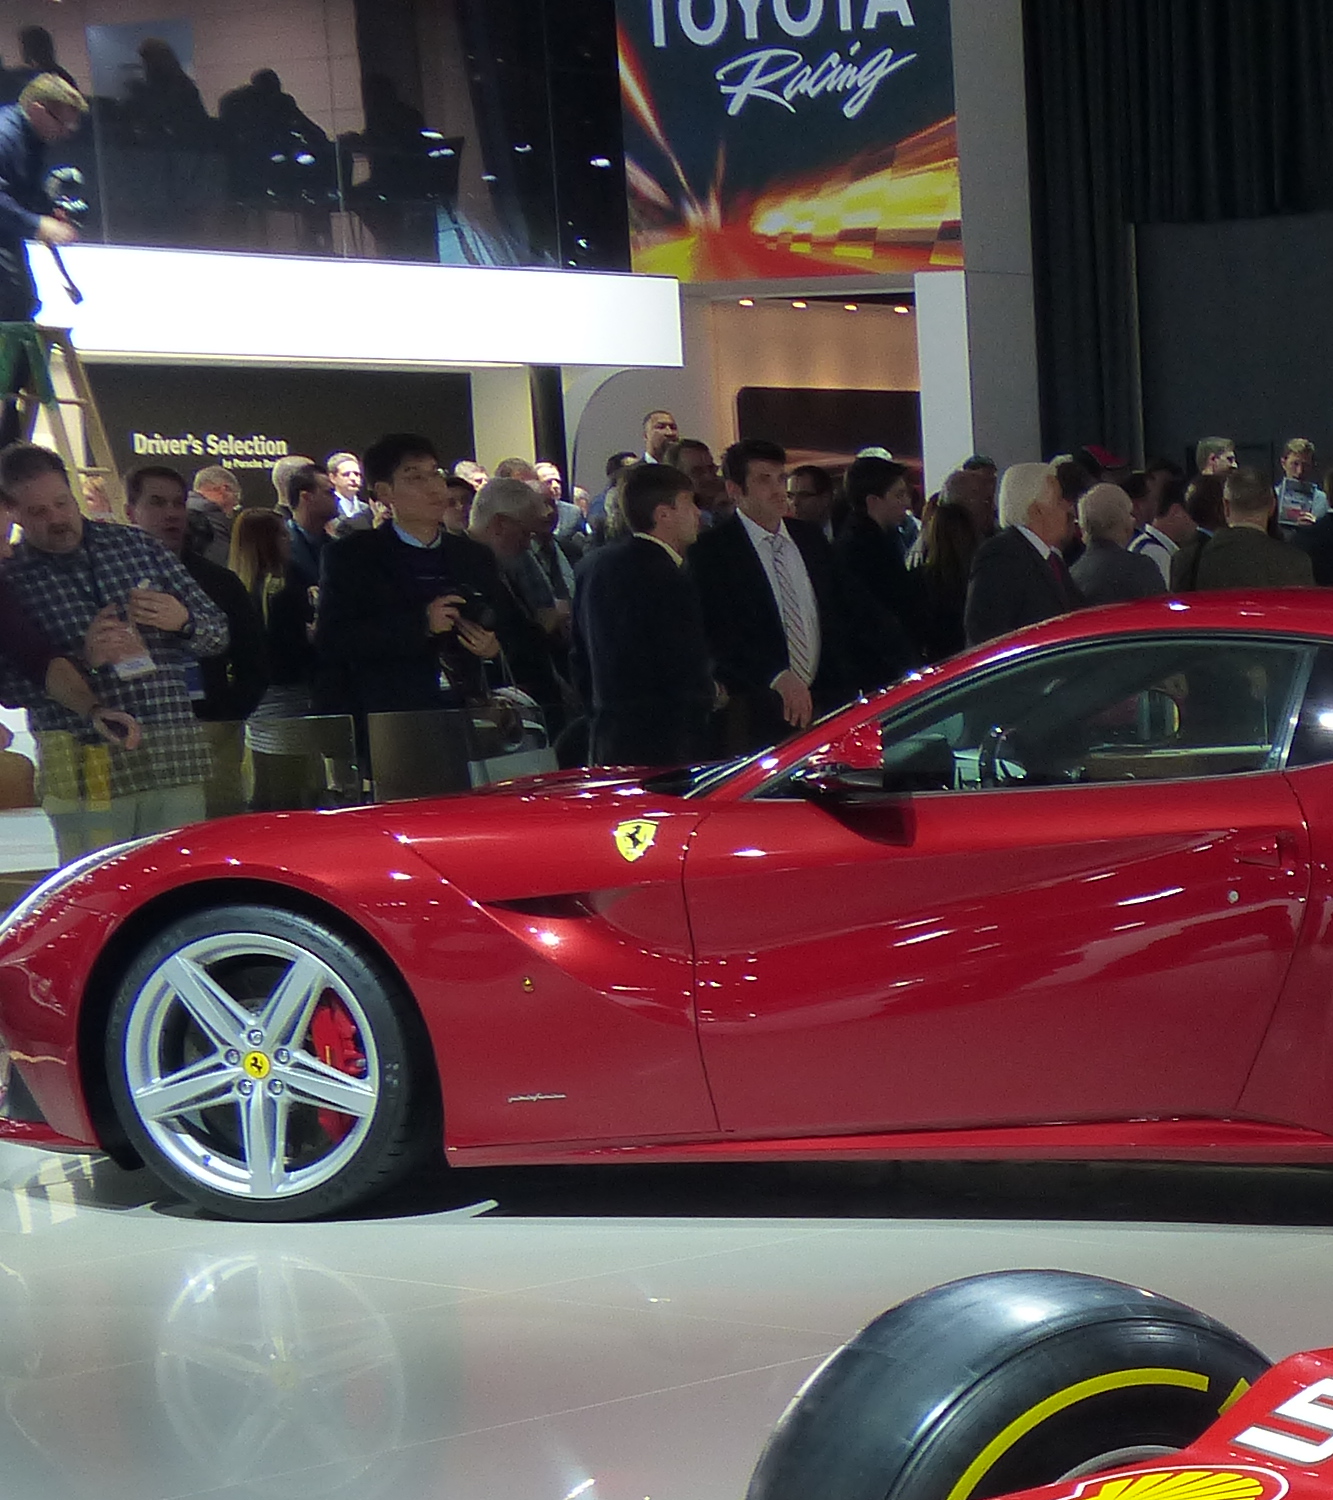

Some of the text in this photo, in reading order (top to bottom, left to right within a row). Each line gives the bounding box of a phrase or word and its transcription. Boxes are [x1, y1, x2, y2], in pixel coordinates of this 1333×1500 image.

[715, 41, 917, 118] Racing
[132, 433, 288, 455] Driver's Selection
